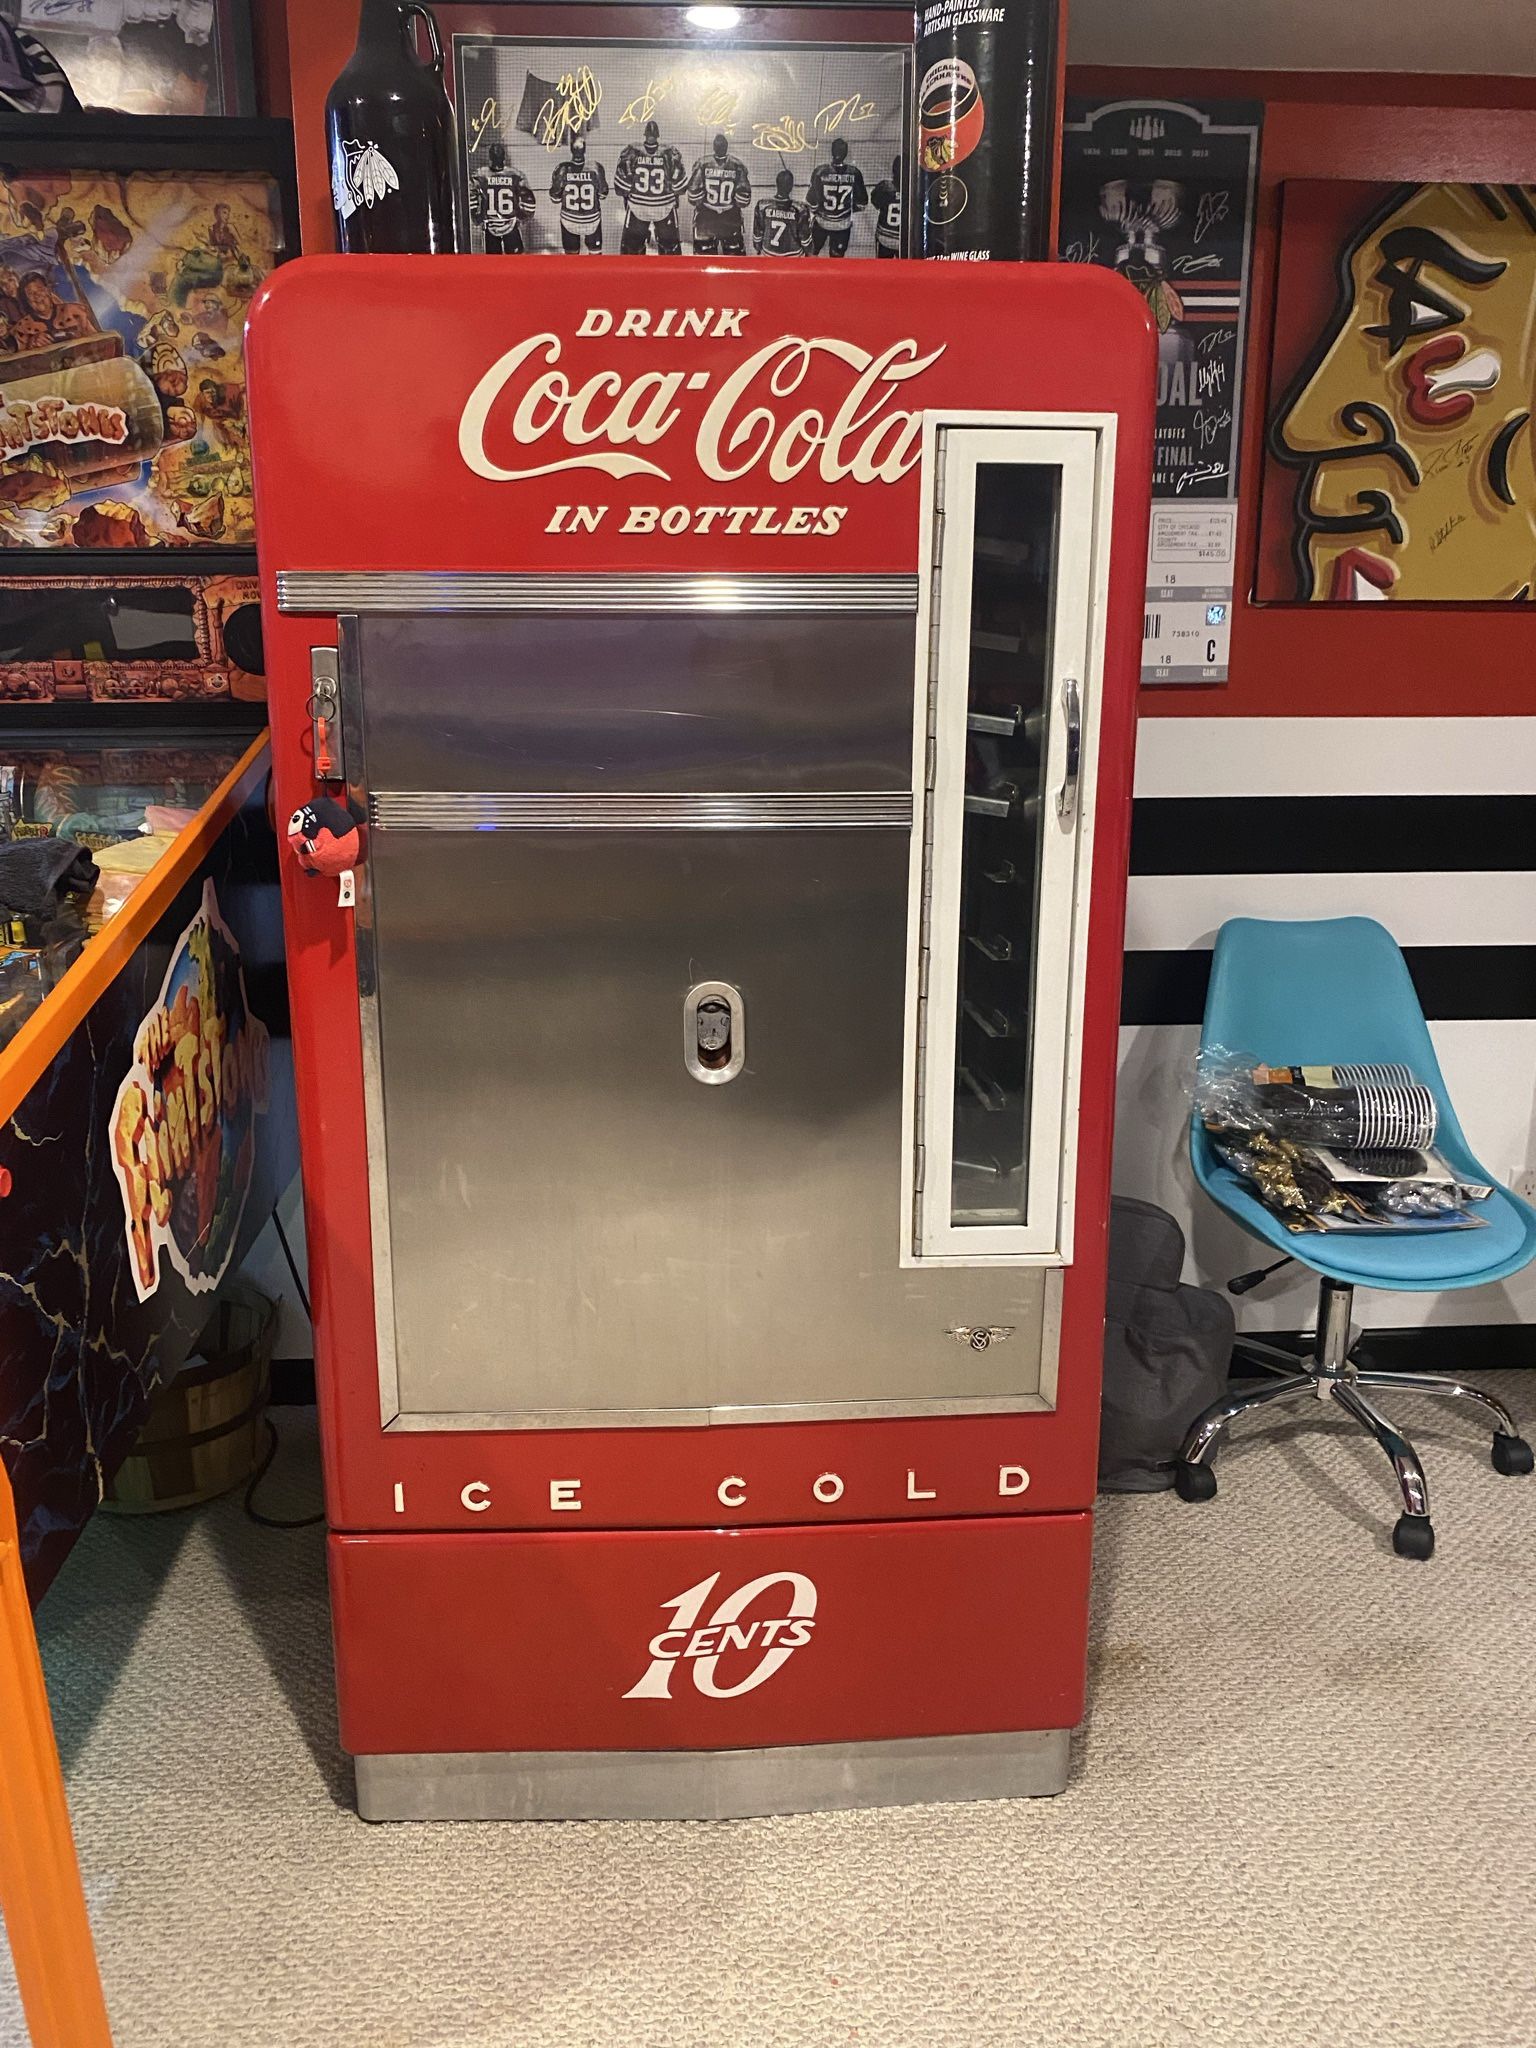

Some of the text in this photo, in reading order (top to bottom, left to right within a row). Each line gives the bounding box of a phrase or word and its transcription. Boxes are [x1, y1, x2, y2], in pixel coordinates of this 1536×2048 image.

[923, 8, 1006, 37] ARTISAN GLASSWARE
[926, 64, 960, 83] CHICAGO
[487, 177, 512, 186] KRUGER
[635, 167, 665, 194] 33
[705, 179, 735, 205] 50
[486, 188, 514, 215] 16
[564, 184, 595, 210] 29
[823, 185, 853, 210] 57
[770, 220, 787, 246] 7
[950, 252, 969, 261] WINE
[969, 250, 990, 261] GLASS
[576, 308, 749, 338] DRINK
[458, 333, 947, 484] Coca-Cola
[1157, 446, 1195, 466] FINAL
[544, 506, 848, 536] IN BOTTLES
[1165, 574, 1176, 584] 18
[1161, 588, 1174, 598] SEAT
[1160, 655, 1172, 664] 18
[1206, 639, 1216, 662] C
[1156, 668, 1169, 678] SEAT
[394, 1465, 1030, 1512] ICE COLD
[621, 1571, 818, 1699] 10
[648, 1618, 816, 1660] CENTS
